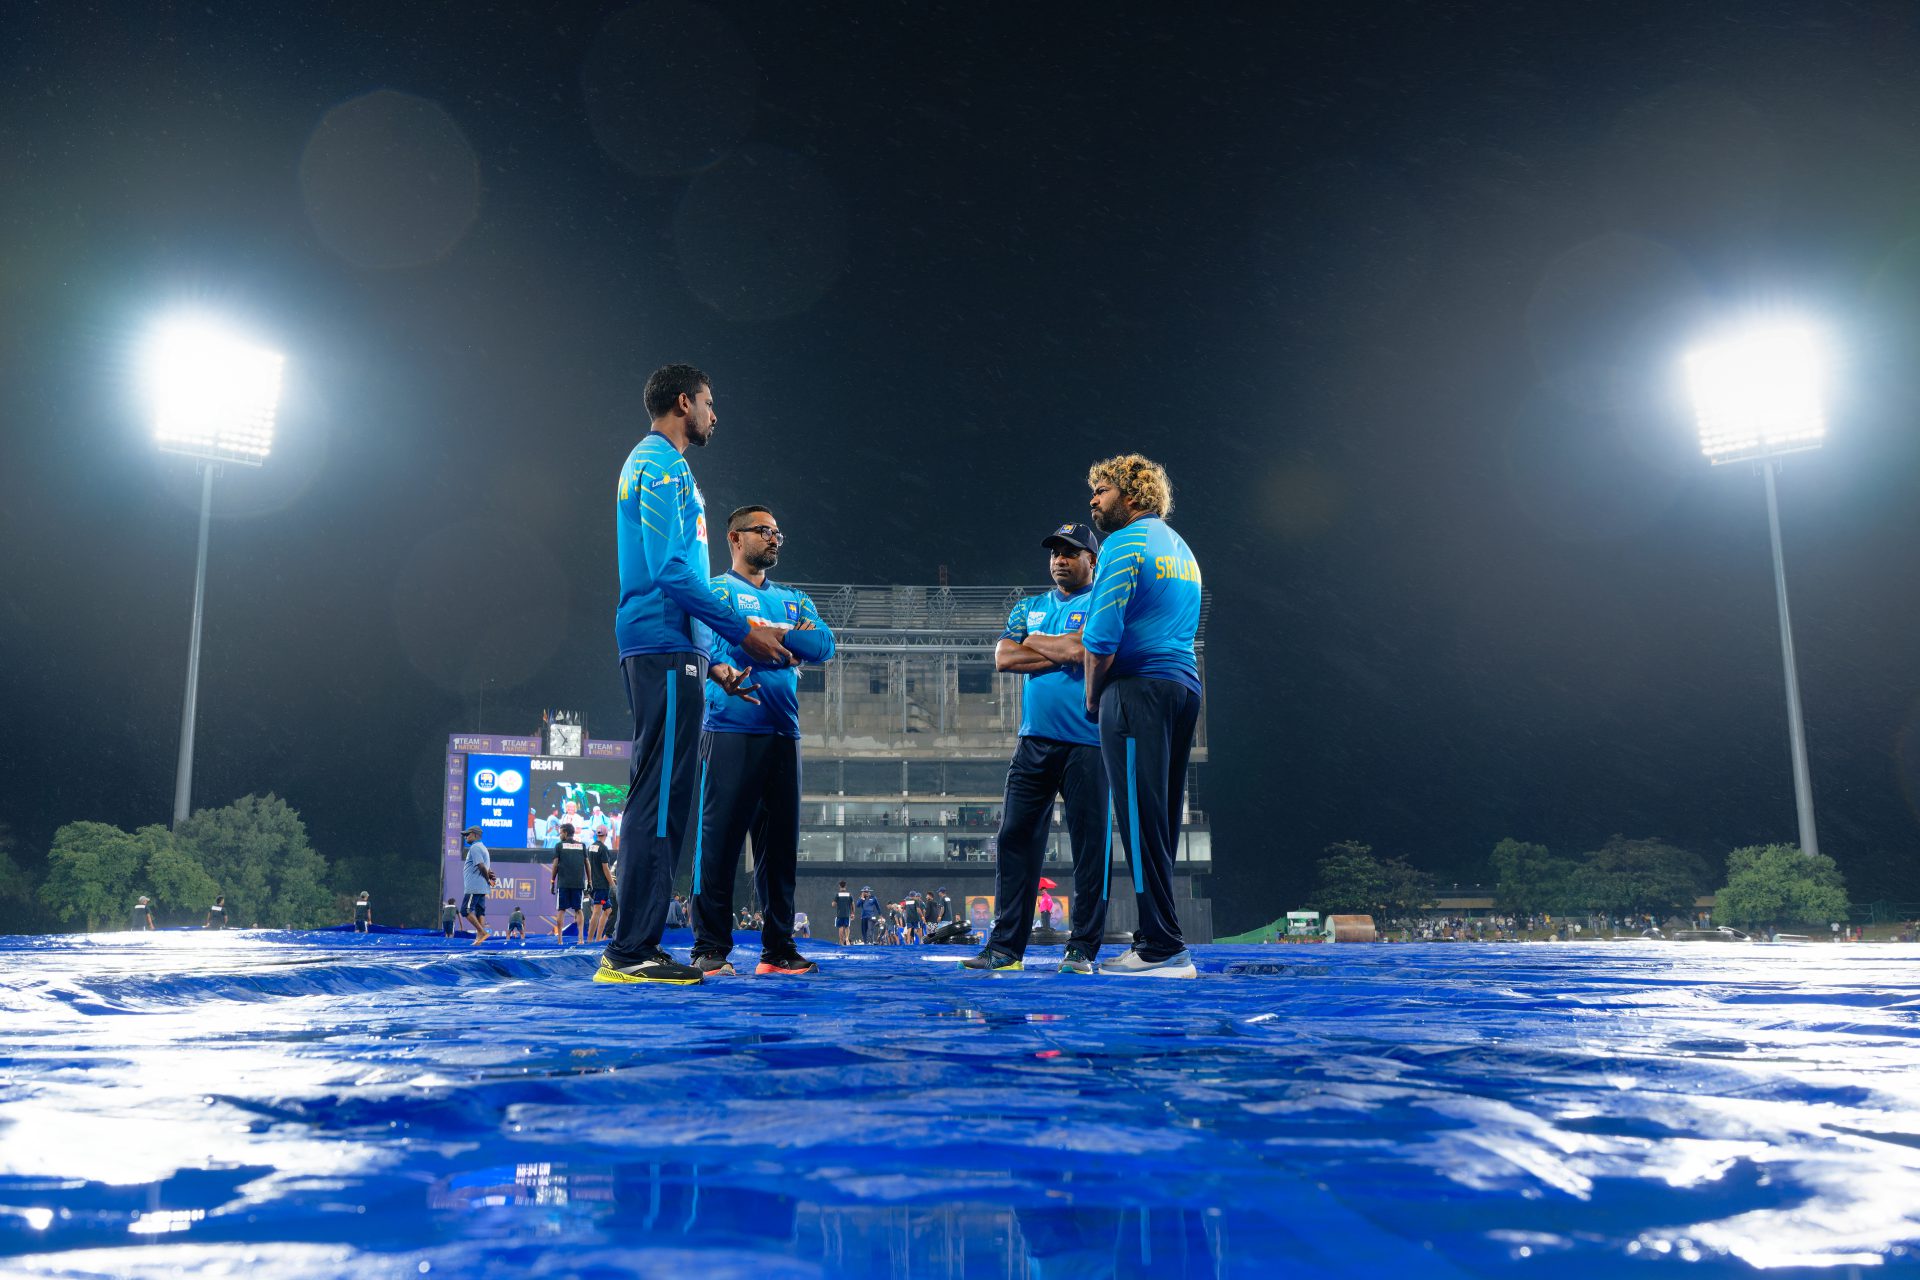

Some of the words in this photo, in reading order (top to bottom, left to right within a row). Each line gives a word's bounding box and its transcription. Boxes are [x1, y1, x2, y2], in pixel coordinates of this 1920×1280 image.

[1155, 556, 1178, 579] SRI
[1178, 558, 1201, 584] LAN
[552, 760, 564, 771] PM
[481, 797, 492, 806] SRI
[493, 797, 515, 807] LANKA
[493, 808, 502, 817] VS
[481, 818, 513, 828] PAKISTAN
[490, 877, 514, 889] AM
[485, 889, 514, 900] ATION
